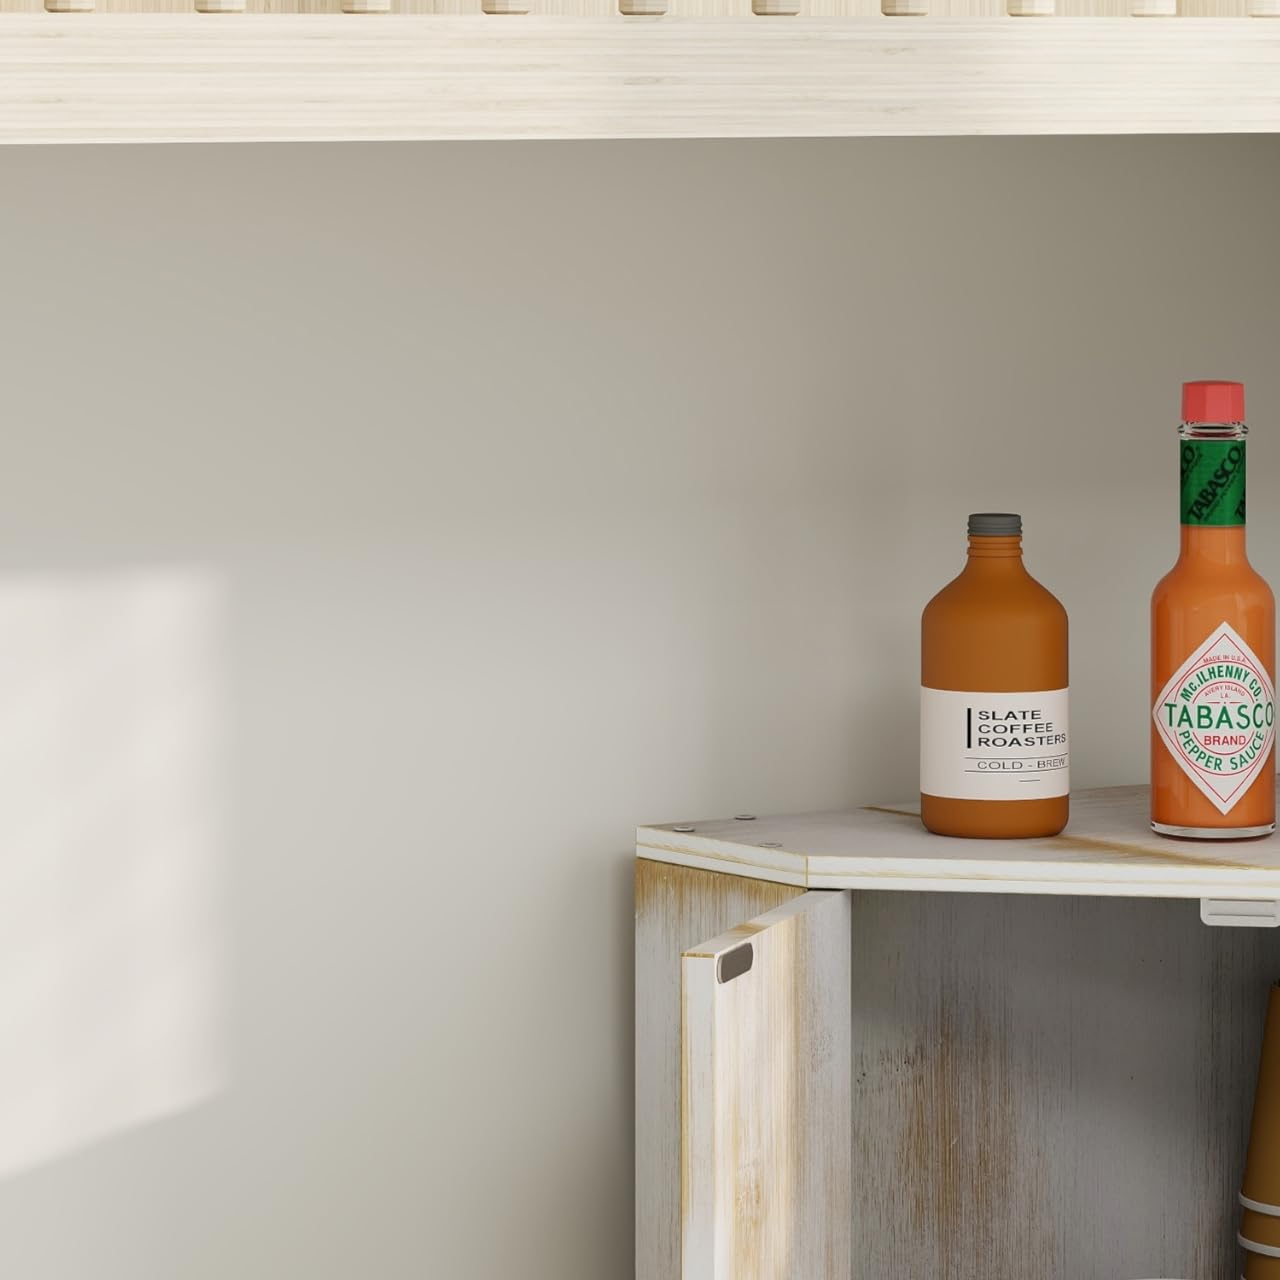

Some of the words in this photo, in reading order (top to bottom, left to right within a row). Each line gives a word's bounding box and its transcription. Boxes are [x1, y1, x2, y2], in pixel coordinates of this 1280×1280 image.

[1188, 446, 1241, 520] TABASCO
[1203, 655, 1221, 663] MADE
[1204, 685, 1223, 697] AVERY
[1225, 685, 1245, 697] ISLAND
[978, 710, 1042, 721] SLATE
[1164, 701, 1274, 730] TABASCO
[978, 722, 1054, 734] COFFEE
[978, 733, 1066, 748] ROASTERS
[1204, 736, 1247, 746] BRAND
[1179, 730, 1223, 771] PEPPER
[1230, 732, 1265, 771] SAUCE
[977, 761, 1023, 770] COLD
[1037, 758, 1066, 769] BREW
